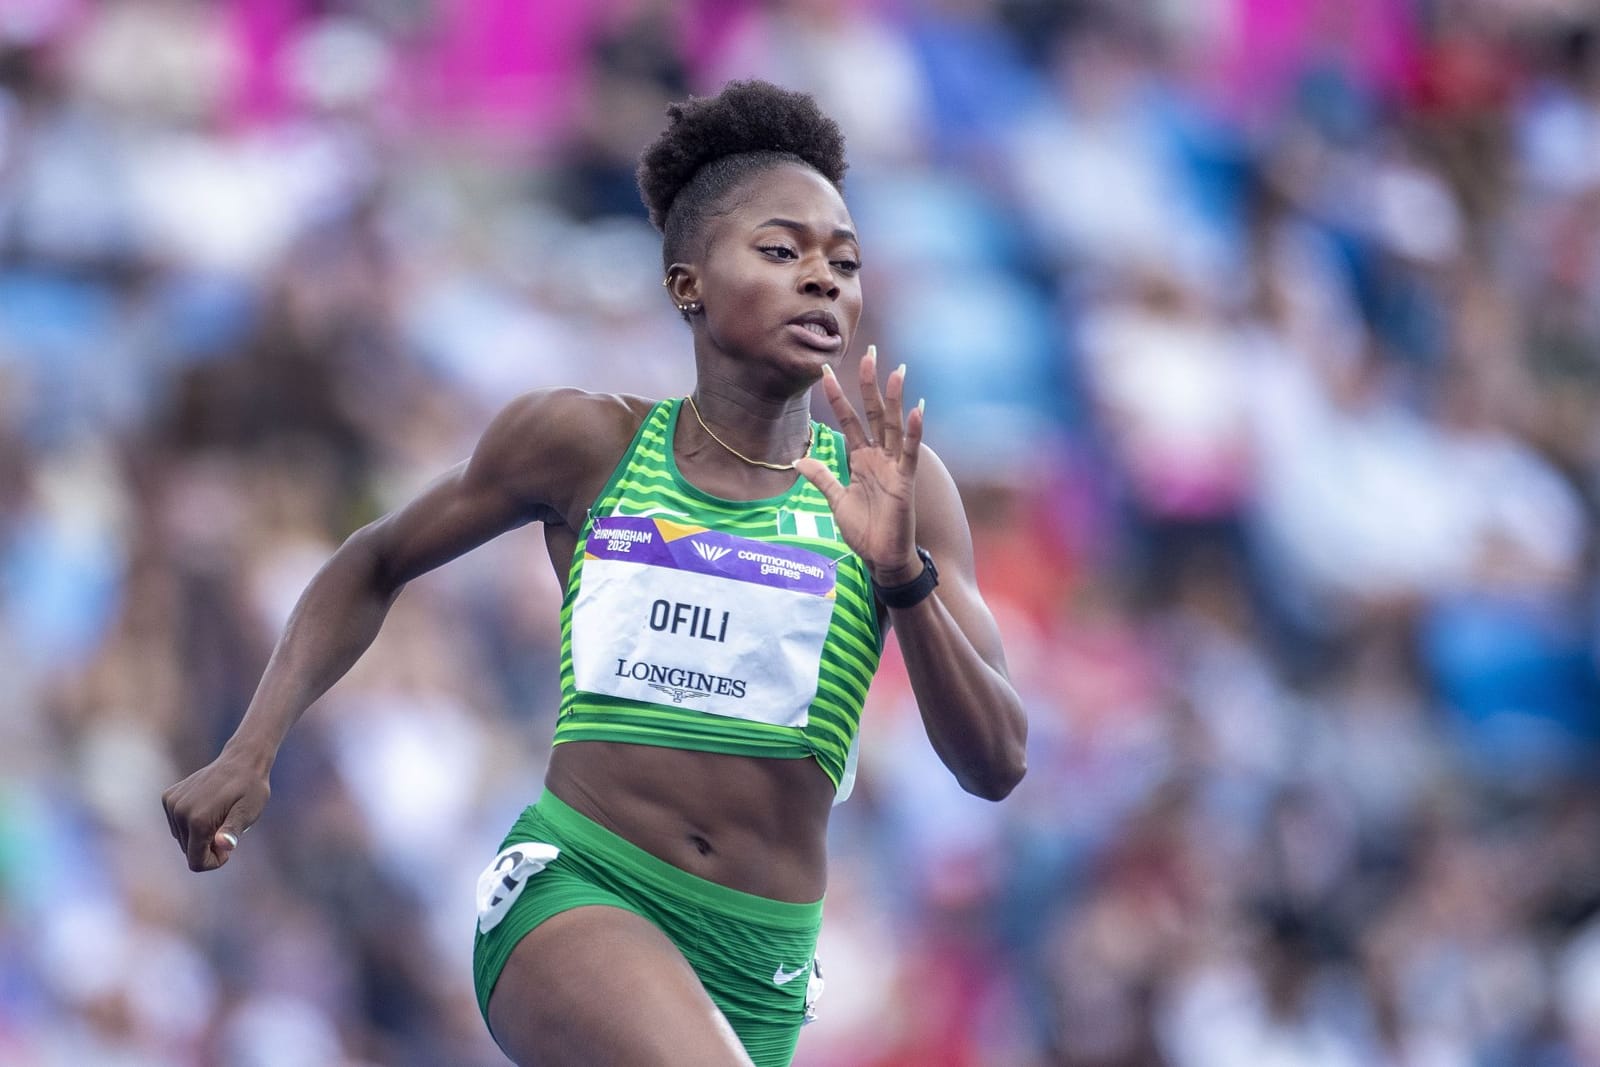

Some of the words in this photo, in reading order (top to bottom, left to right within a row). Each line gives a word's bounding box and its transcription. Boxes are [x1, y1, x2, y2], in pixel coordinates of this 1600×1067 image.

[594, 529, 652, 544] BIRMINGHAM
[607, 540, 631, 552] 2022
[738, 550, 824, 579] commonwealth
[761, 563, 800, 580] games
[650, 600, 730, 643] OFILI
[615, 659, 747, 698] LONGINES
